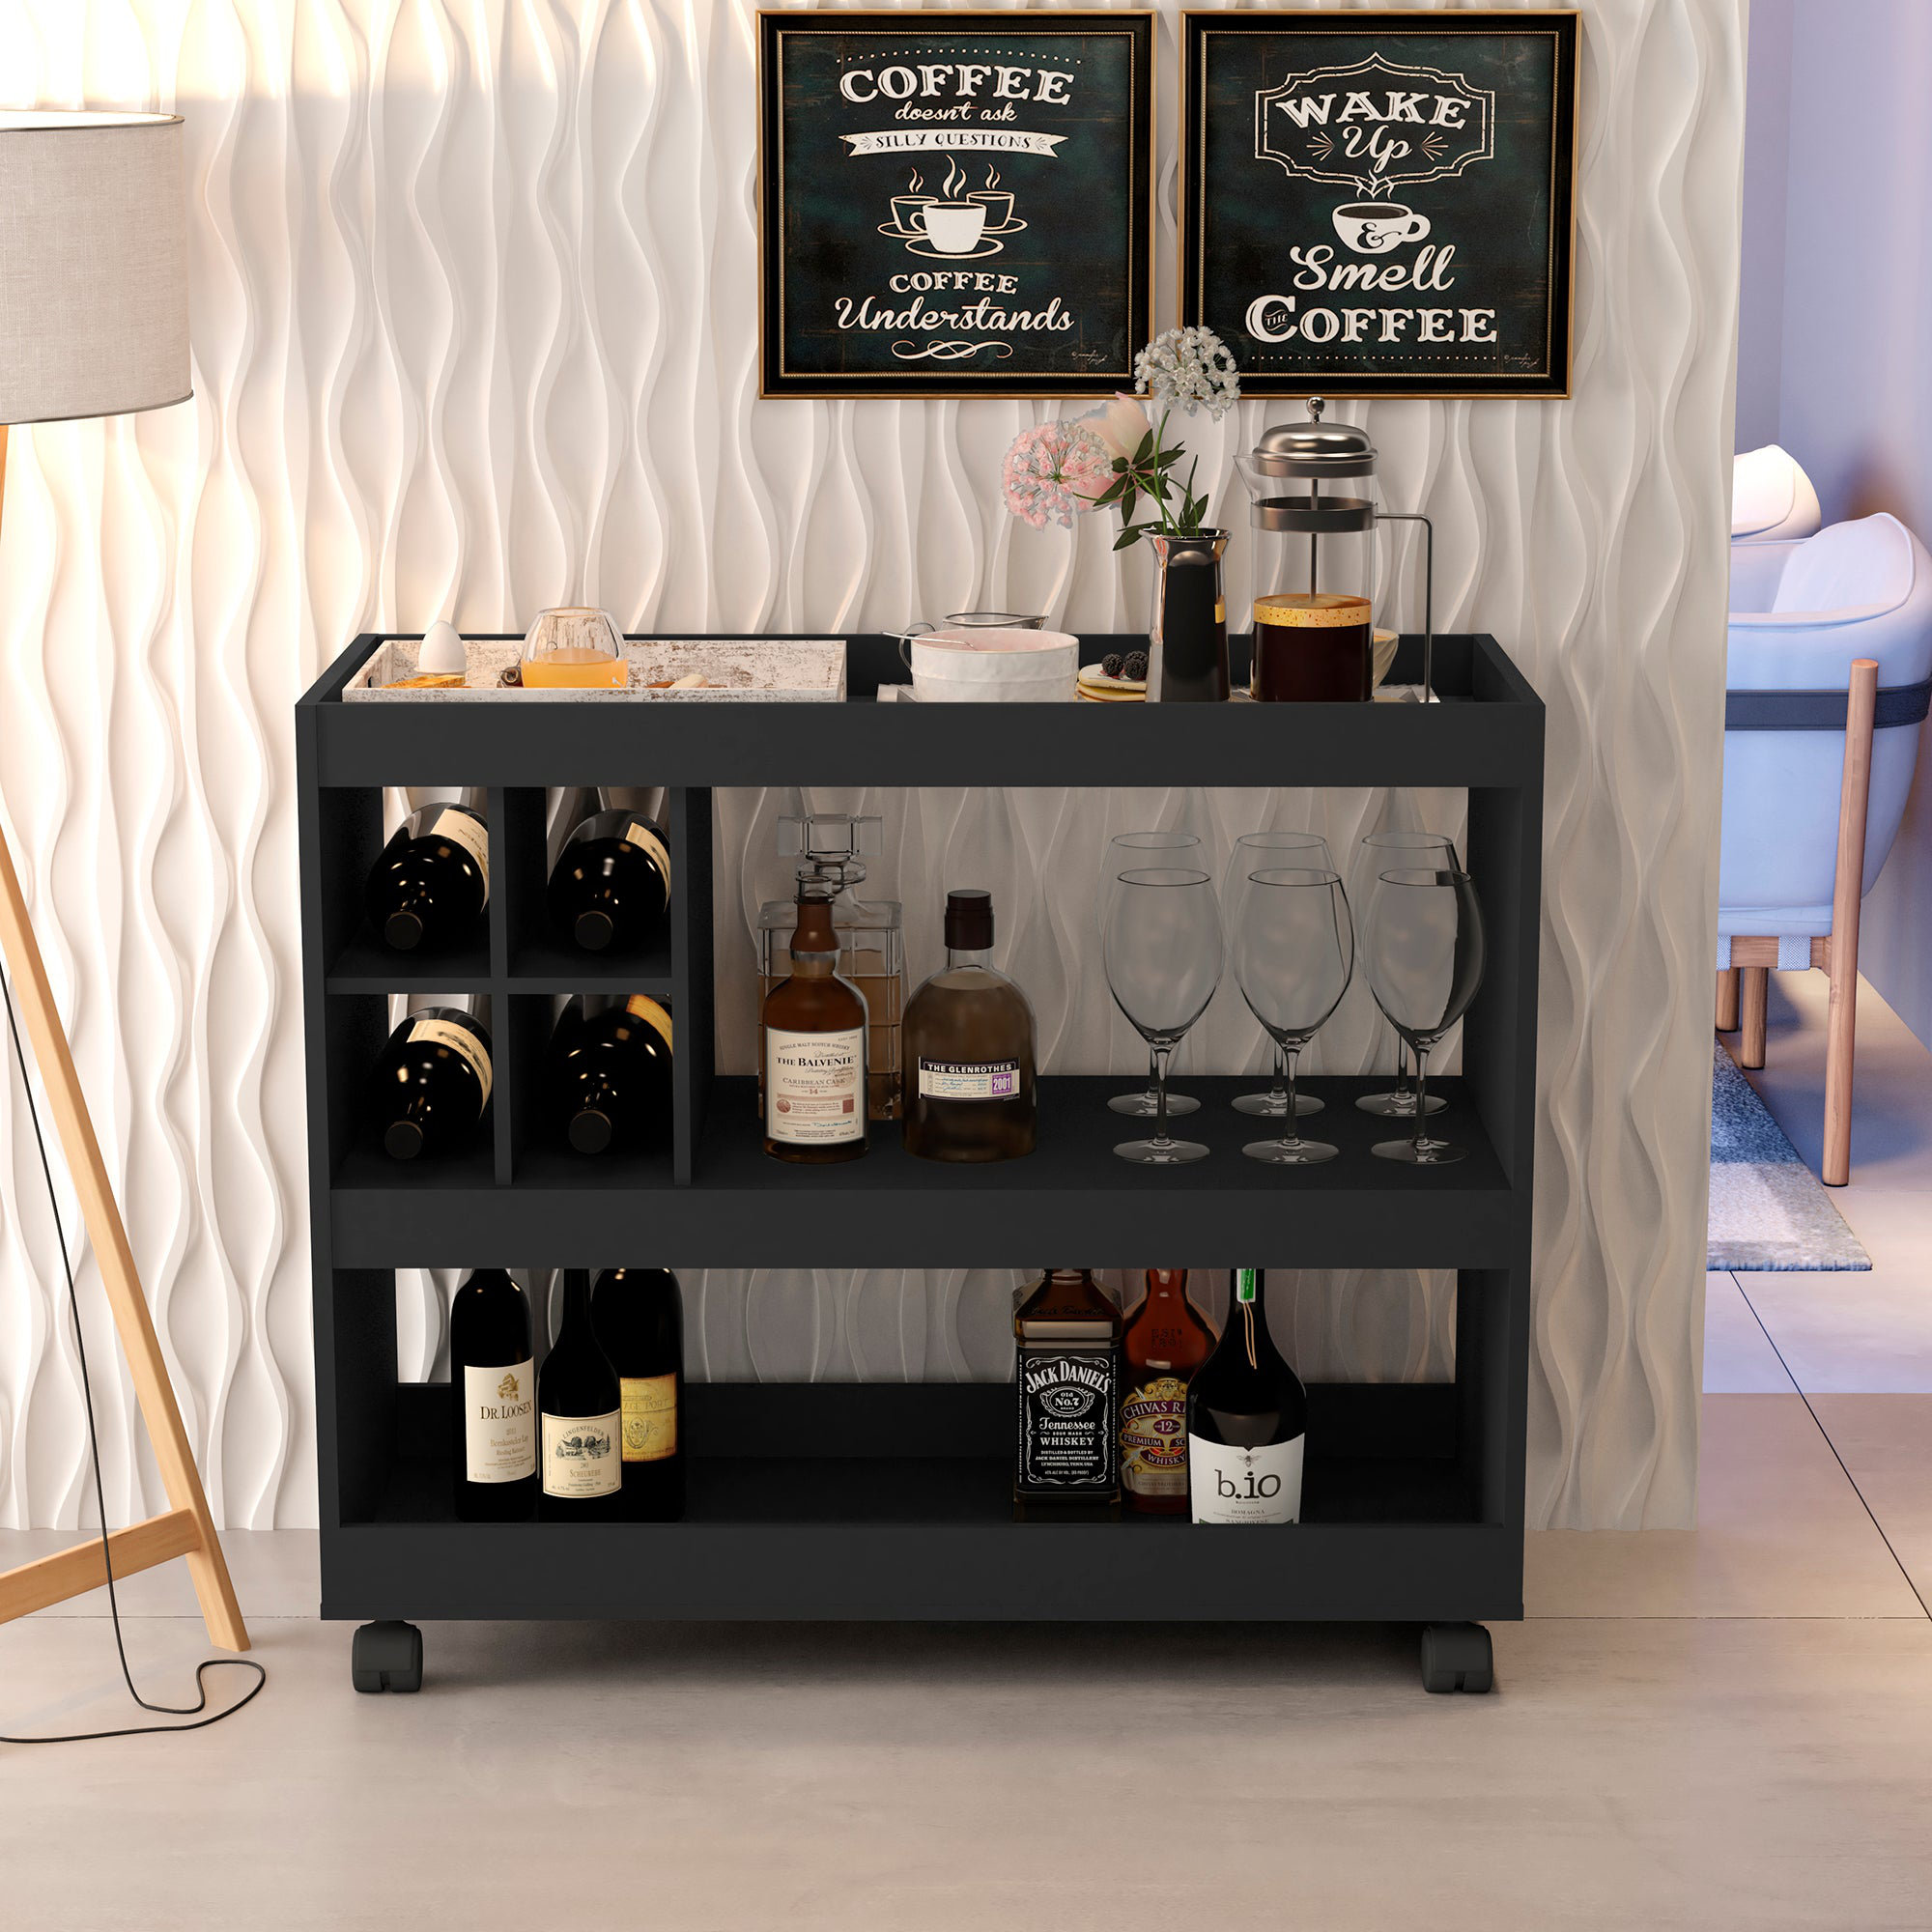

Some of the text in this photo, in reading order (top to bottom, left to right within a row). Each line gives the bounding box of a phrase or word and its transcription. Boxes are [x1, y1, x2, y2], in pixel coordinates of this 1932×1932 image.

[838, 64, 1075, 104] COFFEE
[980, 101, 1017, 122] ask
[1275, 91, 1472, 129] WAKE
[876, 132, 1031, 149] SILLY QUESTIONS
[1343, 125, 1412, 173] Up
[1356, 222, 1403, 248] &
[1290, 243, 1456, 291] Smell
[889, 271, 1019, 295] COFFEE
[835, 296, 1075, 331] Understands
[1245, 295, 1497, 343] COFFEE
[777, 1057, 796, 1065] THE
[927, 1064, 1012, 1074] THE GLENROTHES
[993, 1077, 1011, 1091] 2001
[1025, 1360, 1112, 1394] JACK DANIEL'S
[1123, 1402, 1168, 1420] CHIVAS
[1039, 1417, 1095, 1430] Tennessee
[1160, 1420, 1173, 1432] 12
[1039, 1437, 1094, 1446] WHISKEY
[1123, 1434, 1162, 1446] PREMIUM
[1148, 1453, 1185, 1465] WHISKY
[1214, 1468, 1282, 1499] b.io
